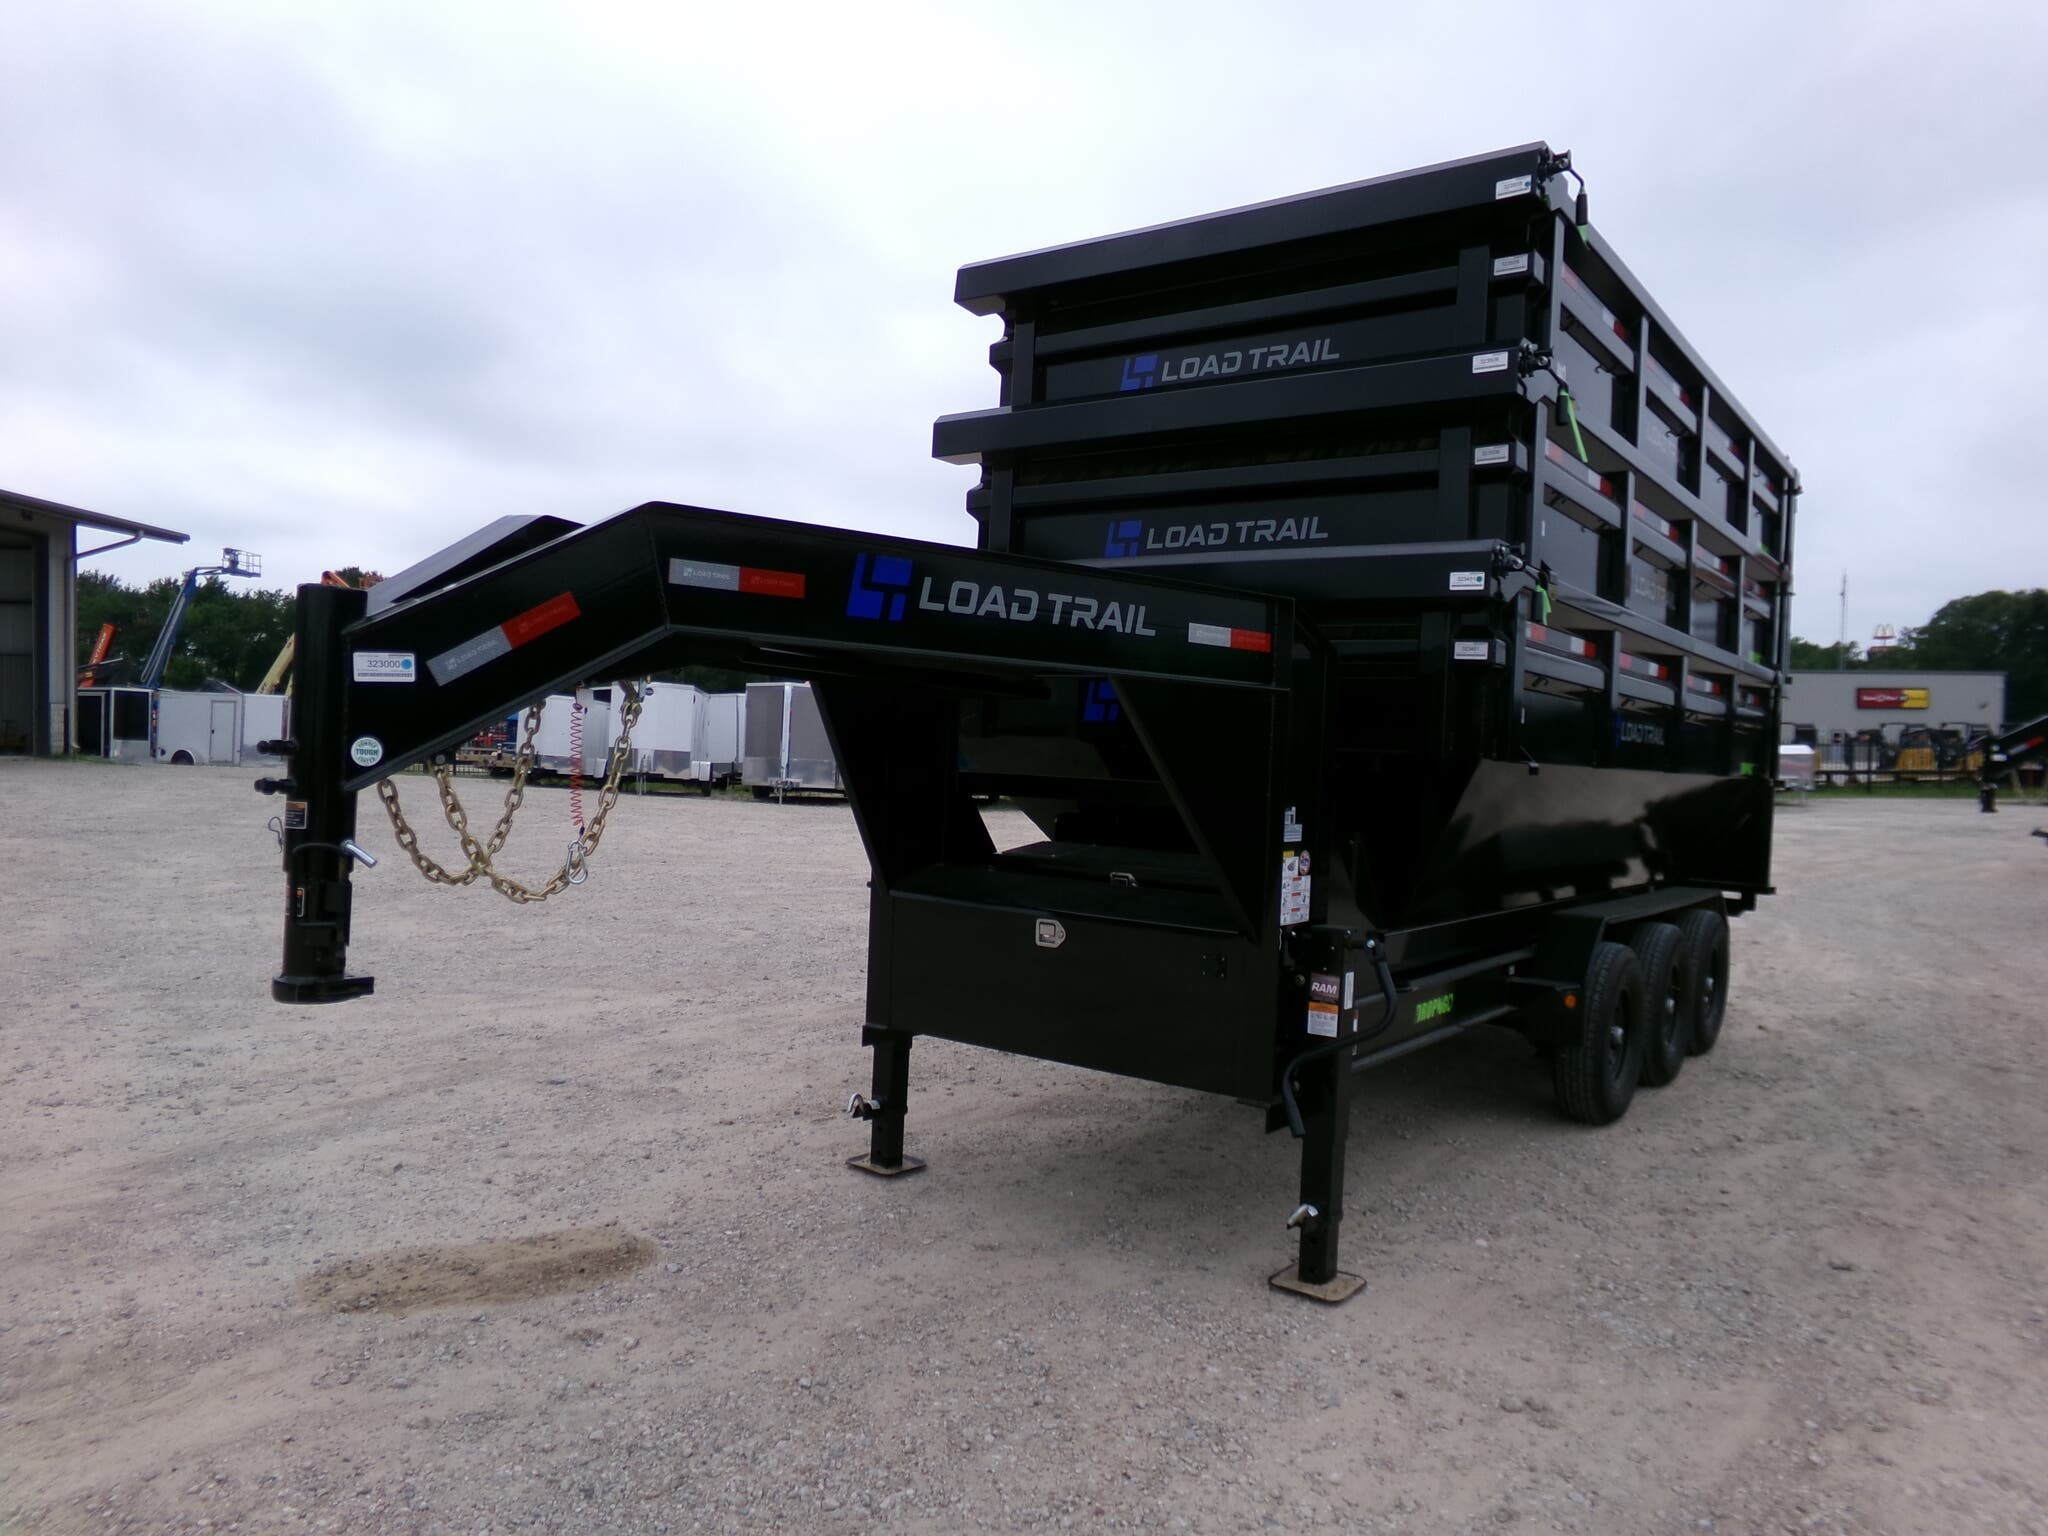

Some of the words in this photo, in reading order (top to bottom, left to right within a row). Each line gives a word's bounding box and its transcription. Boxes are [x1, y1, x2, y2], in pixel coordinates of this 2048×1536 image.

[1161, 351, 1242, 382] LOAD
[1248, 337, 1341, 370] TRAIL
[1145, 522, 1230, 550] LOAD
[1235, 516, 1329, 544] TRAIL
[918, 576, 1040, 623] LOAD
[1047, 592, 1157, 638] TRAIL
[367, 659, 401, 669] 323000
[356, 748, 379, 756] TOUGH
[1311, 982, 1338, 995] RAM
